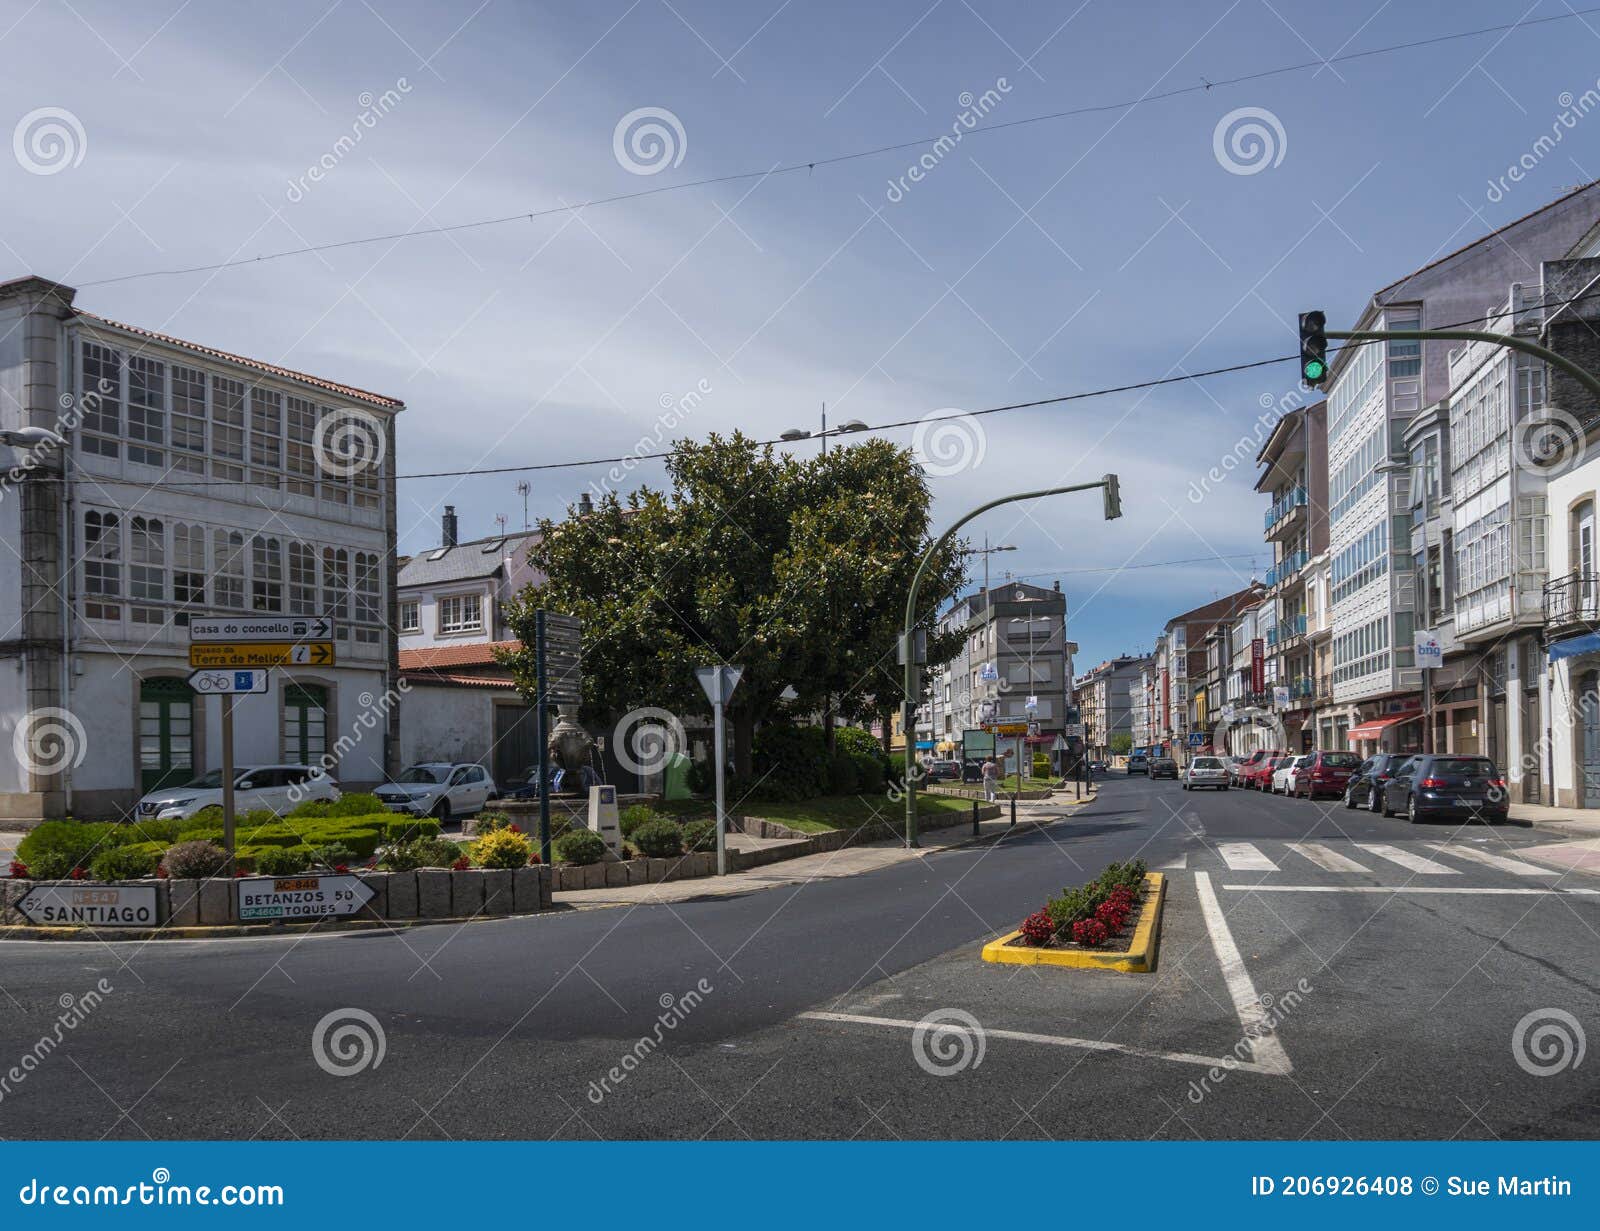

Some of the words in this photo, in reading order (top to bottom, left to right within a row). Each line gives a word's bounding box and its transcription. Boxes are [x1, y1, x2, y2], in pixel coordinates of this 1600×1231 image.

[193, 625, 219, 634] casa
[224, 623, 238, 634] do
[242, 623, 289, 633] concello
[1418, 644, 1441, 656] bng
[194, 655, 227, 664] Terra
[230, 655, 245, 664] de
[247, 653, 288, 664] Melide
[245, 891, 324, 905] BETANZOS
[335, 890, 353, 901] 50
[26, 898, 42, 911] 52
[285, 904, 335, 915] TOQUES
[347, 904, 354, 913] 7
[43, 906, 150, 922] SANTIAGO
